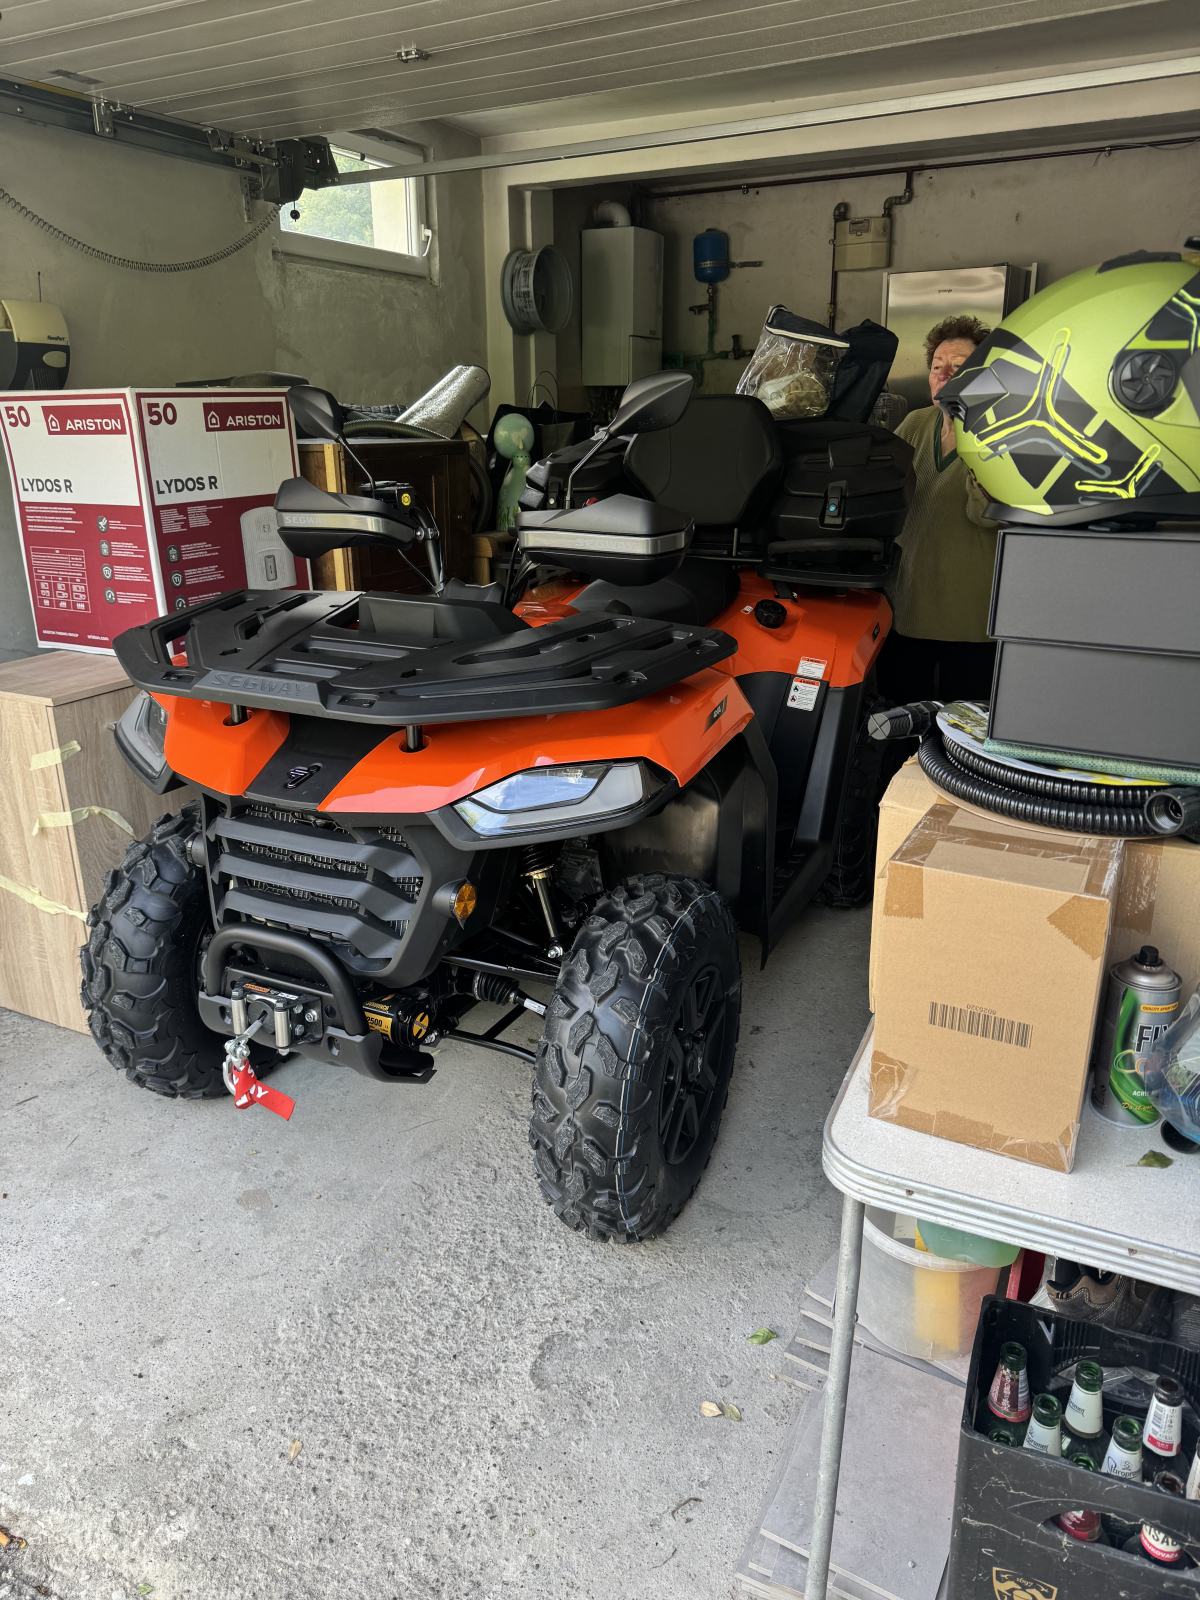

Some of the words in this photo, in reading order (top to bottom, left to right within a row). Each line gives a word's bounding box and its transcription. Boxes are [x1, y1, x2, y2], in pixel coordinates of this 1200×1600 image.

[4, 405, 31, 428] 50
[146, 402, 178, 426] 50
[226, 414, 281, 427] ARISTON
[65, 418, 122, 431] ARISTON
[21, 477, 62, 493] LYDOS
[64, 479, 74, 493] R
[156, 476, 206, 495] LYDOS
[208, 475, 219, 490] R
